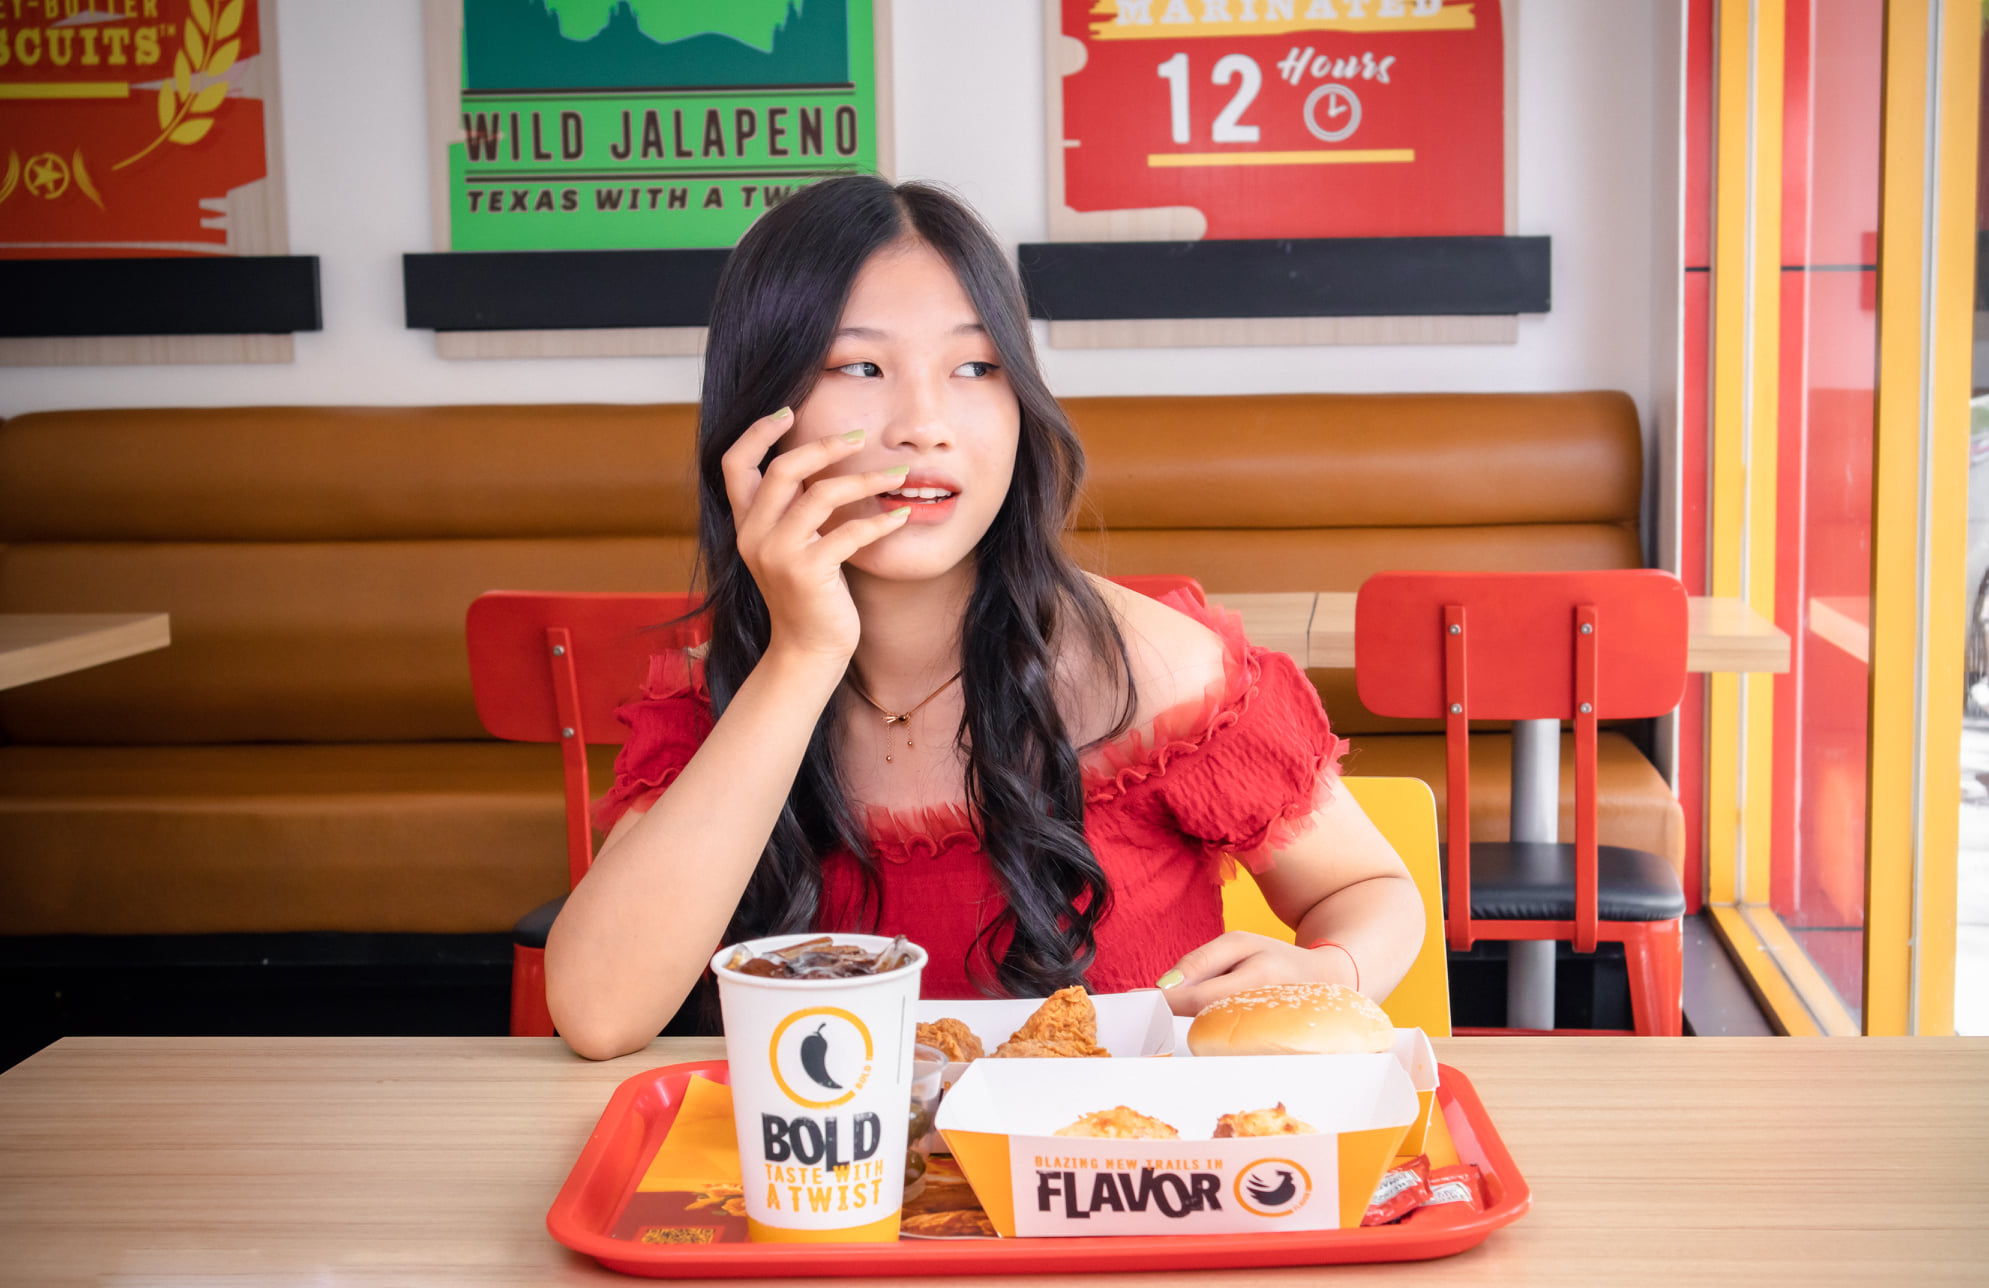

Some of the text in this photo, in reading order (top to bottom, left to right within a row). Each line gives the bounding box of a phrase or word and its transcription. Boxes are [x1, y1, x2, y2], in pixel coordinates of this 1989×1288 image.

[1116, 0, 1443, 25] MARINATED
[1157, 47, 1395, 144] 12 Hours
[463, 104, 859, 162] WILD JALAPENO
[466, 188, 580, 213] TEXAS
[595, 186, 689, 212] WITH
[703, 186, 724, 210] A
[761, 1111, 881, 1172] BOLD
[764, 1159, 884, 1185] TASTE WITH
[1034, 1156, 1223, 1171] BLAZING NEW TRAILS IN
[767, 1178, 882, 1213] A TWIST
[1036, 1167, 1223, 1218] FLAVOR
